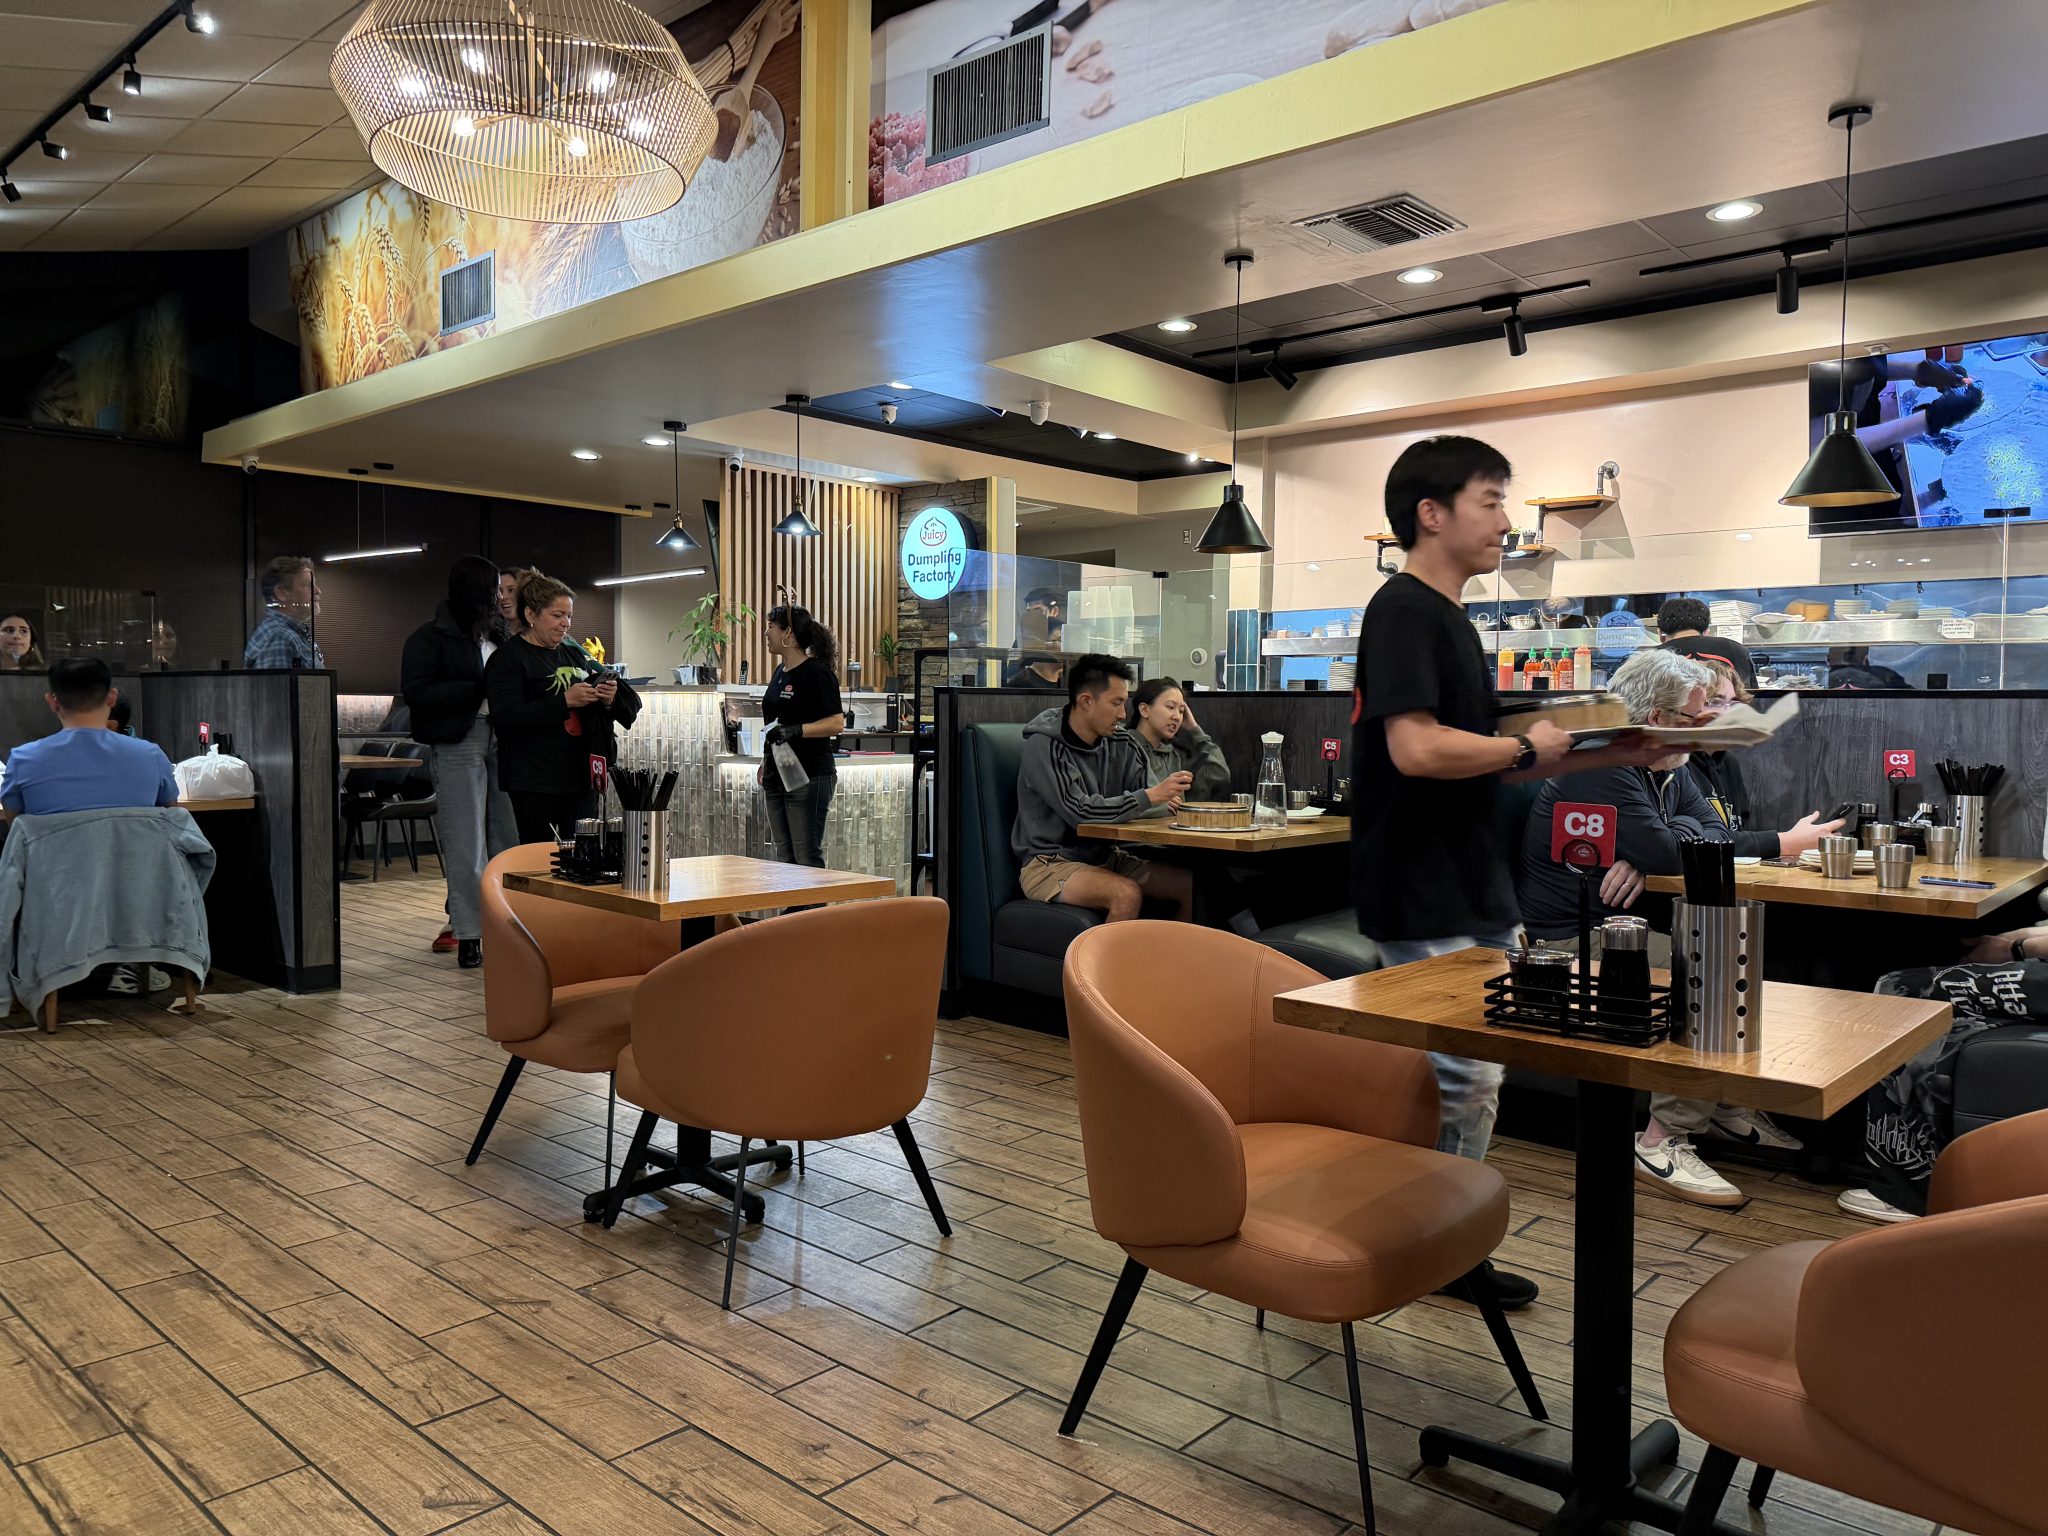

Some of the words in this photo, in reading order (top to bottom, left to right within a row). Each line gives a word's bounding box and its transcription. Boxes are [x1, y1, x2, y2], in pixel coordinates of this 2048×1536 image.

[922, 528, 944, 541] Juicy
[908, 550, 962, 567] Dumpling
[913, 570, 956, 583] Factory
[1324, 741, 1337, 750] C5
[1889, 753, 1910, 766] C3
[592, 760, 603, 775] C9
[1564, 811, 1605, 838] C8
